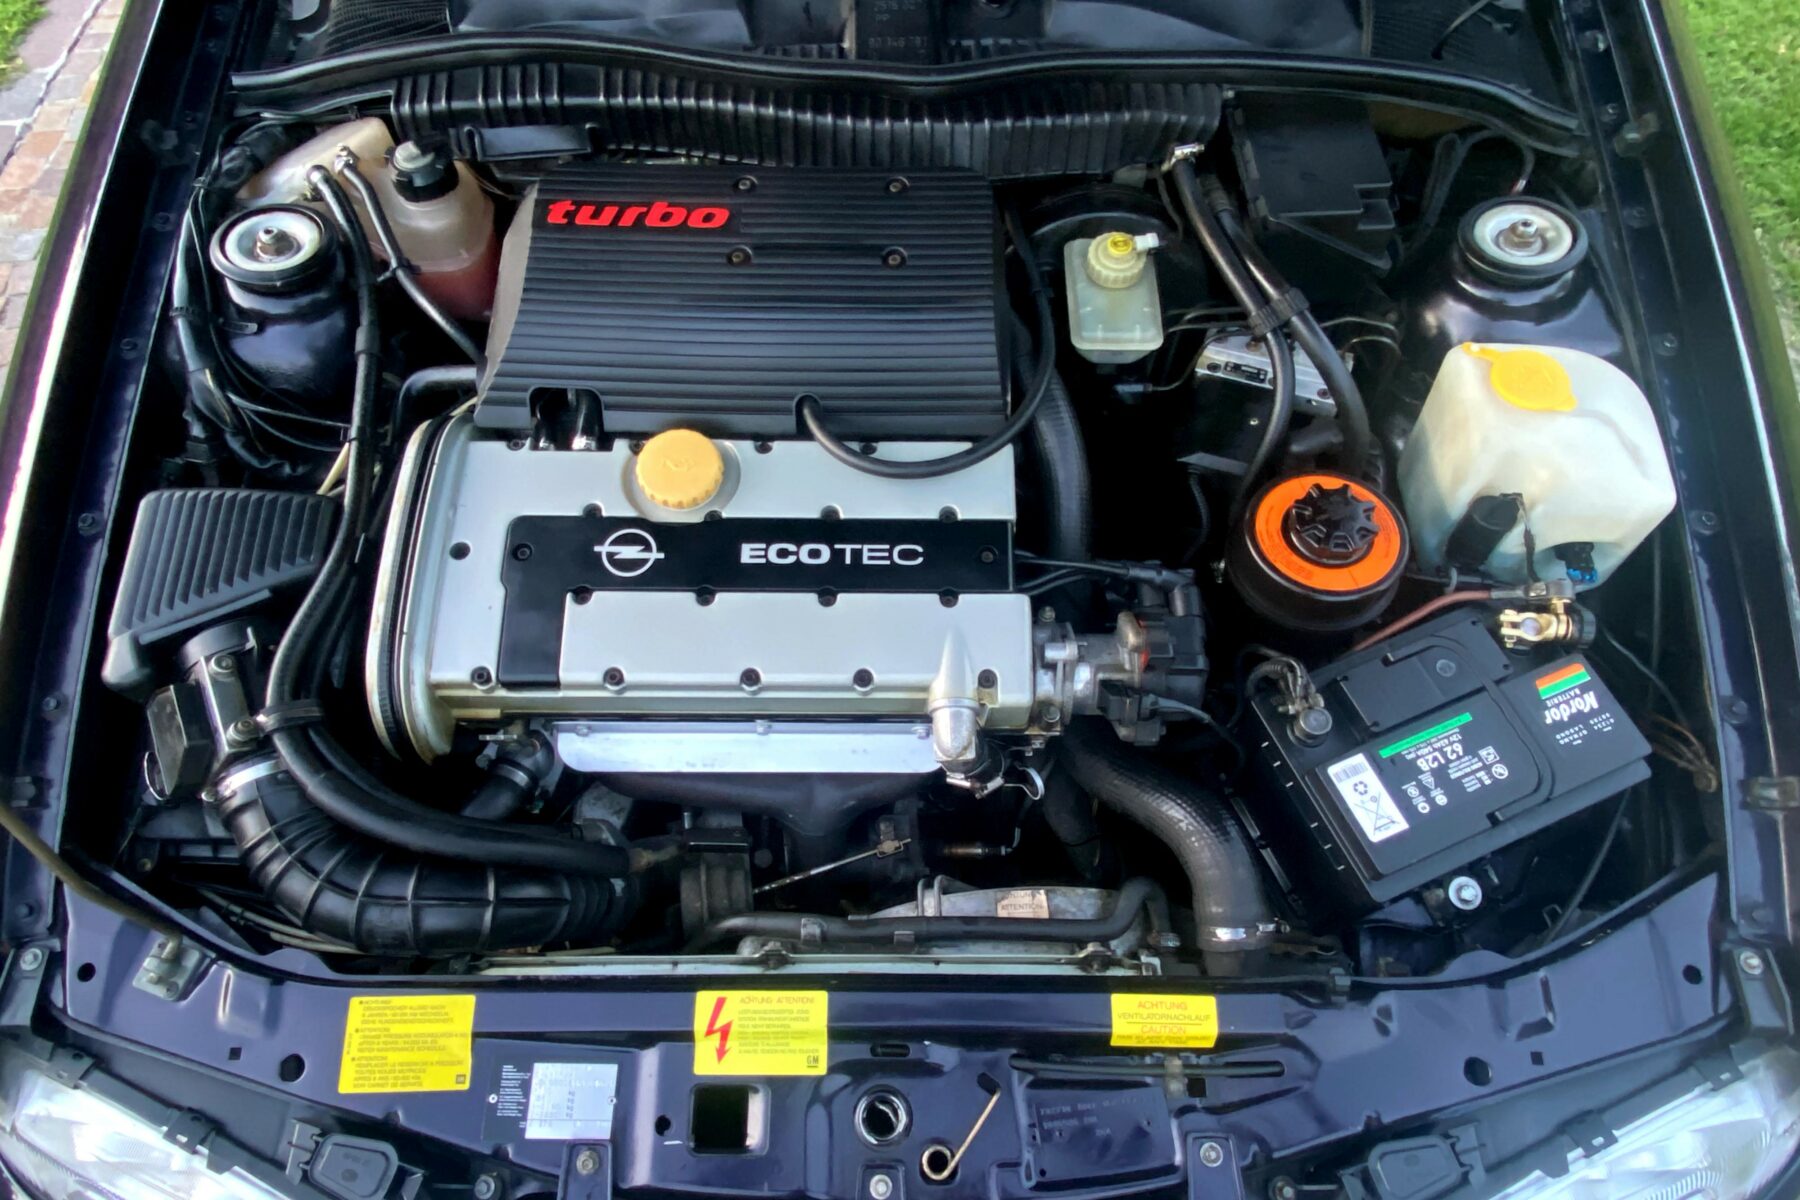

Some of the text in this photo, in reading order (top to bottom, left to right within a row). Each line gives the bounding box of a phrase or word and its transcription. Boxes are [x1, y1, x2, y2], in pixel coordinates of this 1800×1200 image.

[547, 200, 730, 228] turbo
[740, 543, 924, 566] ECOTEC
[1443, 742, 1463, 760] 62
[1416, 751, 1445, 771] L2B
[1137, 1001, 1188, 1011] ACHTUNG
[1141, 1025, 1187, 1035] CAUTION
[806, 1055, 819, 1065] GM
